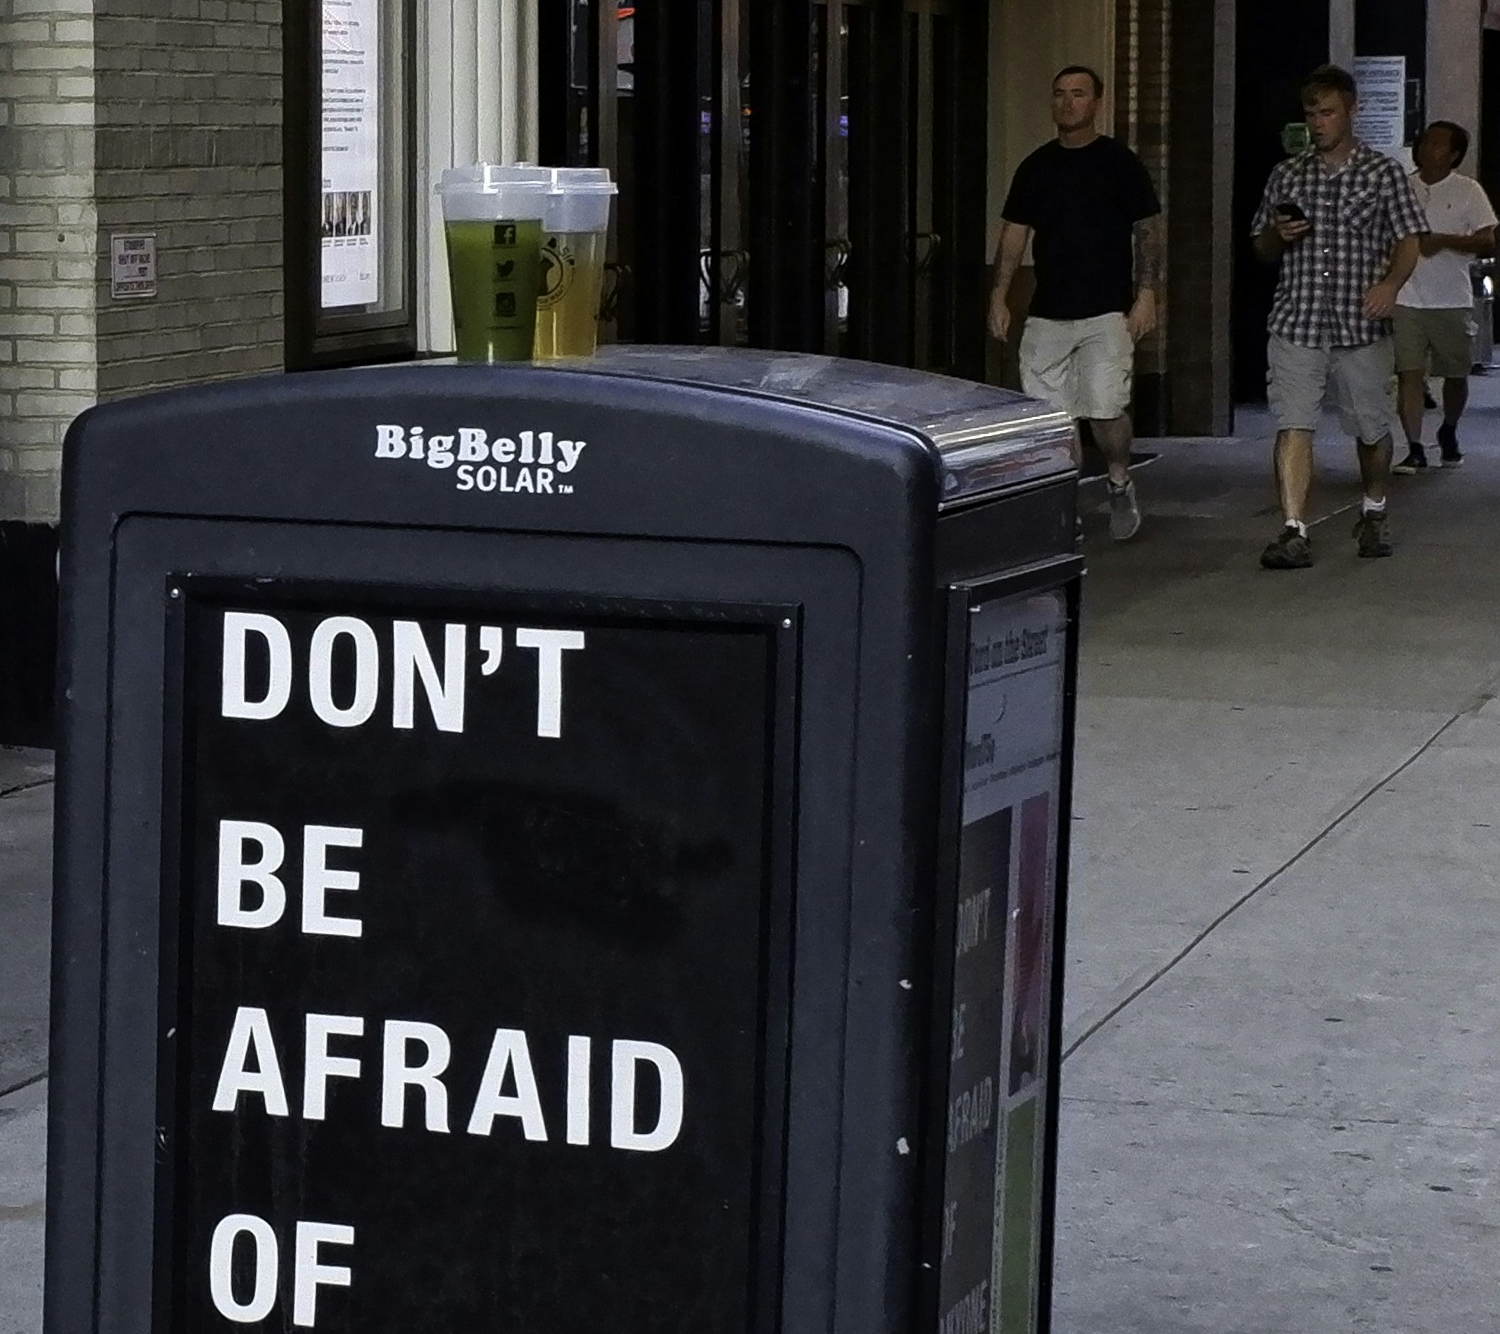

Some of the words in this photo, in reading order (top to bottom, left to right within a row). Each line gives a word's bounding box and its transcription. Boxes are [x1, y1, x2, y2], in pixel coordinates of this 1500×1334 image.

[374, 424, 587, 473] BigBelly
[456, 465, 554, 494] SOLAR
[220, 610, 585, 738] DON'T
[216, 819, 364, 937] BE
[211, 1007, 685, 1153] AFRAID
[208, 1213, 356, 1328] OF
